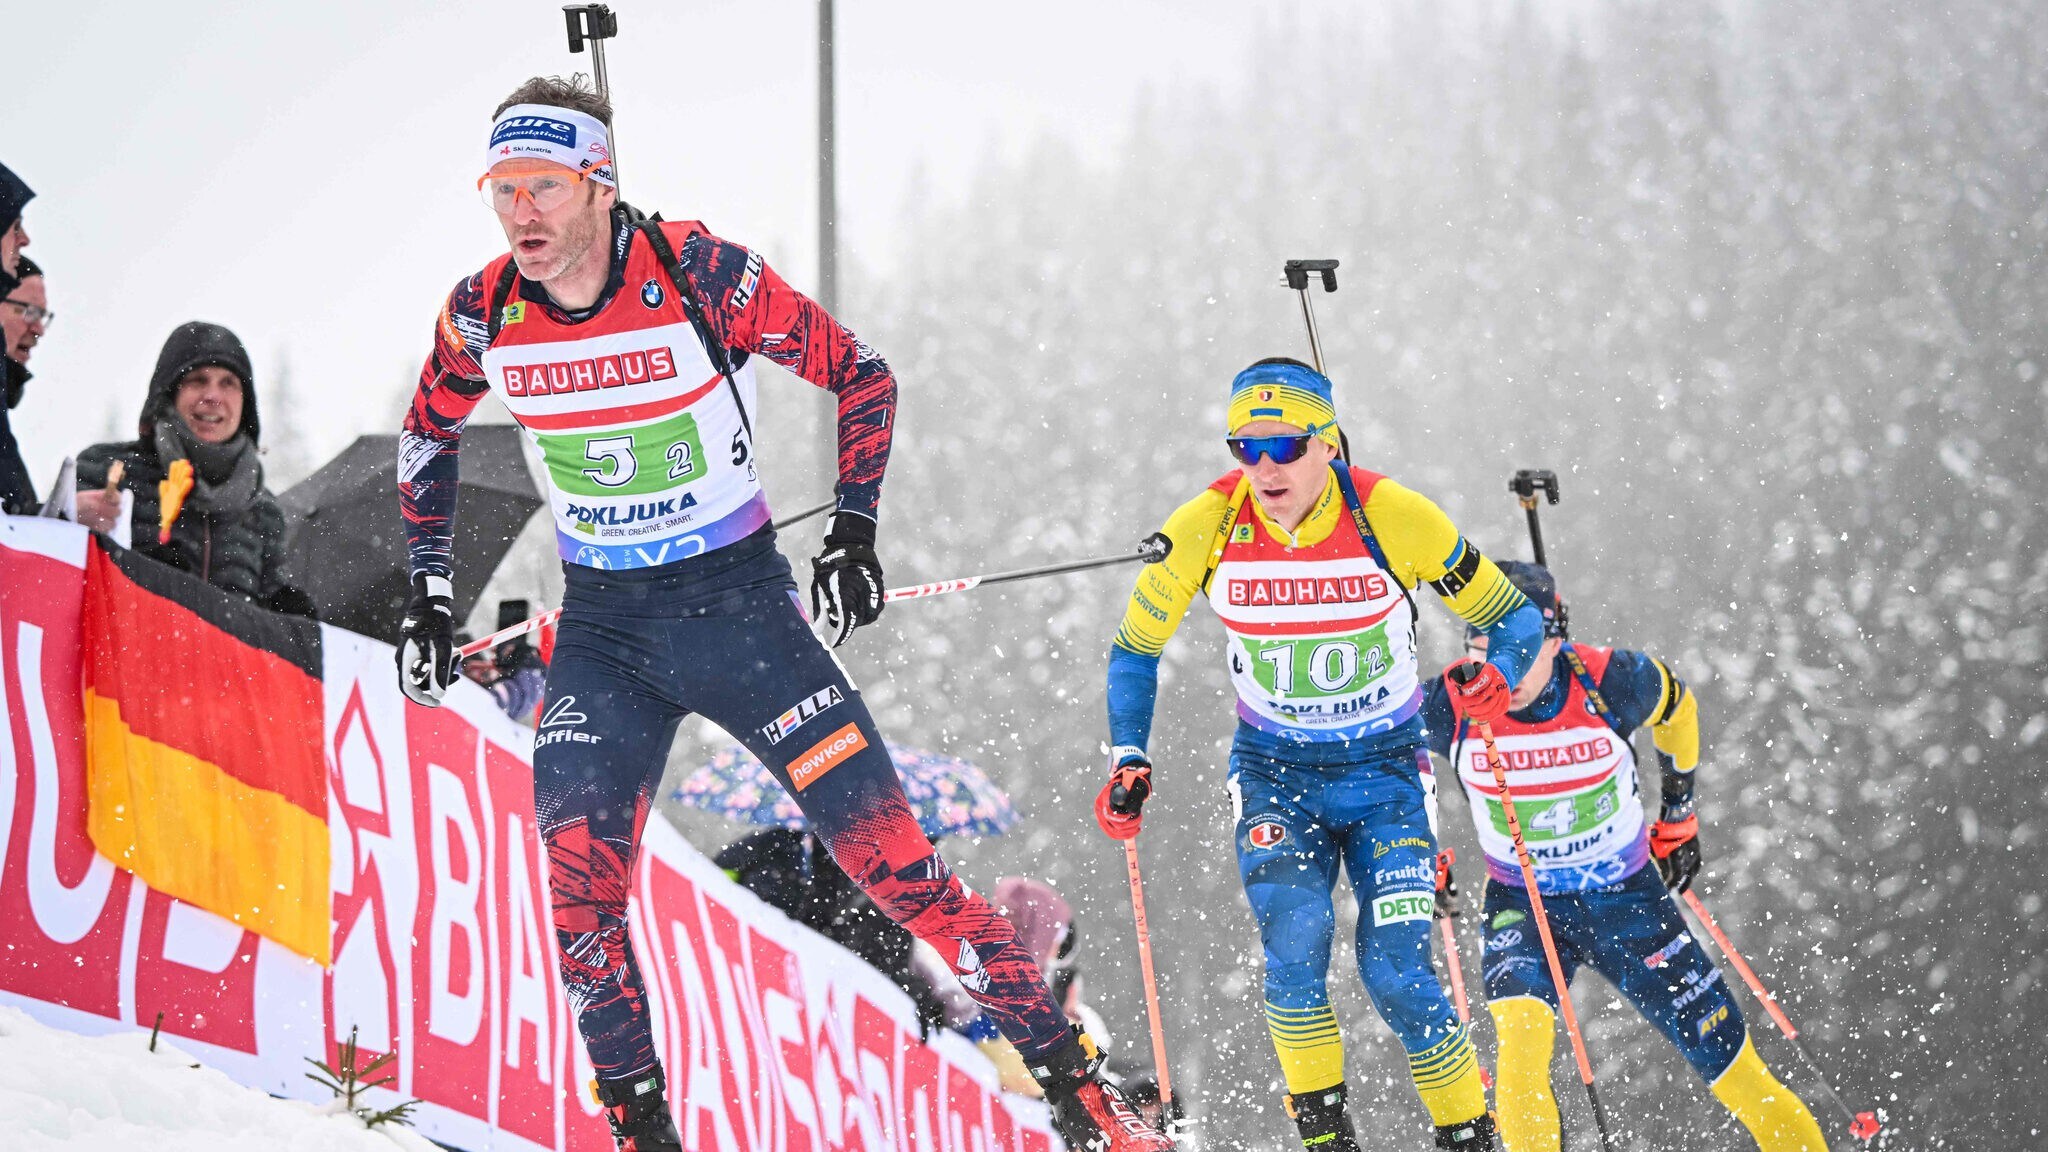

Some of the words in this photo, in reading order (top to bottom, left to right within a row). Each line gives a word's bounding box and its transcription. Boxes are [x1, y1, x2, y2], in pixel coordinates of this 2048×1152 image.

[493, 118, 571, 138] pure
[525, 146, 552, 154] Austria
[618, 224, 629, 260] öffler
[505, 350, 673, 394] BAUHAUS
[583, 436, 636, 487] 5
[667, 442, 692, 480] 2
[731, 426, 747, 466] 5
[601, 528, 626, 537] GREEN.
[628, 521, 664, 536] CREATIVE.
[666, 514, 693, 528] SMART.
[1231, 574, 1386, 603] BAUHAUS
[1260, 642, 1359, 692] 10
[1365, 645, 1386, 679] 2
[767, 687, 843, 744] HELLA
[534, 729, 602, 749] öffler
[793, 731, 858, 783] newkee
[1530, 799, 1577, 838] 4
[1510, 826, 1613, 858] KLJUK
[1303, 1132, 1337, 1147] CHER
